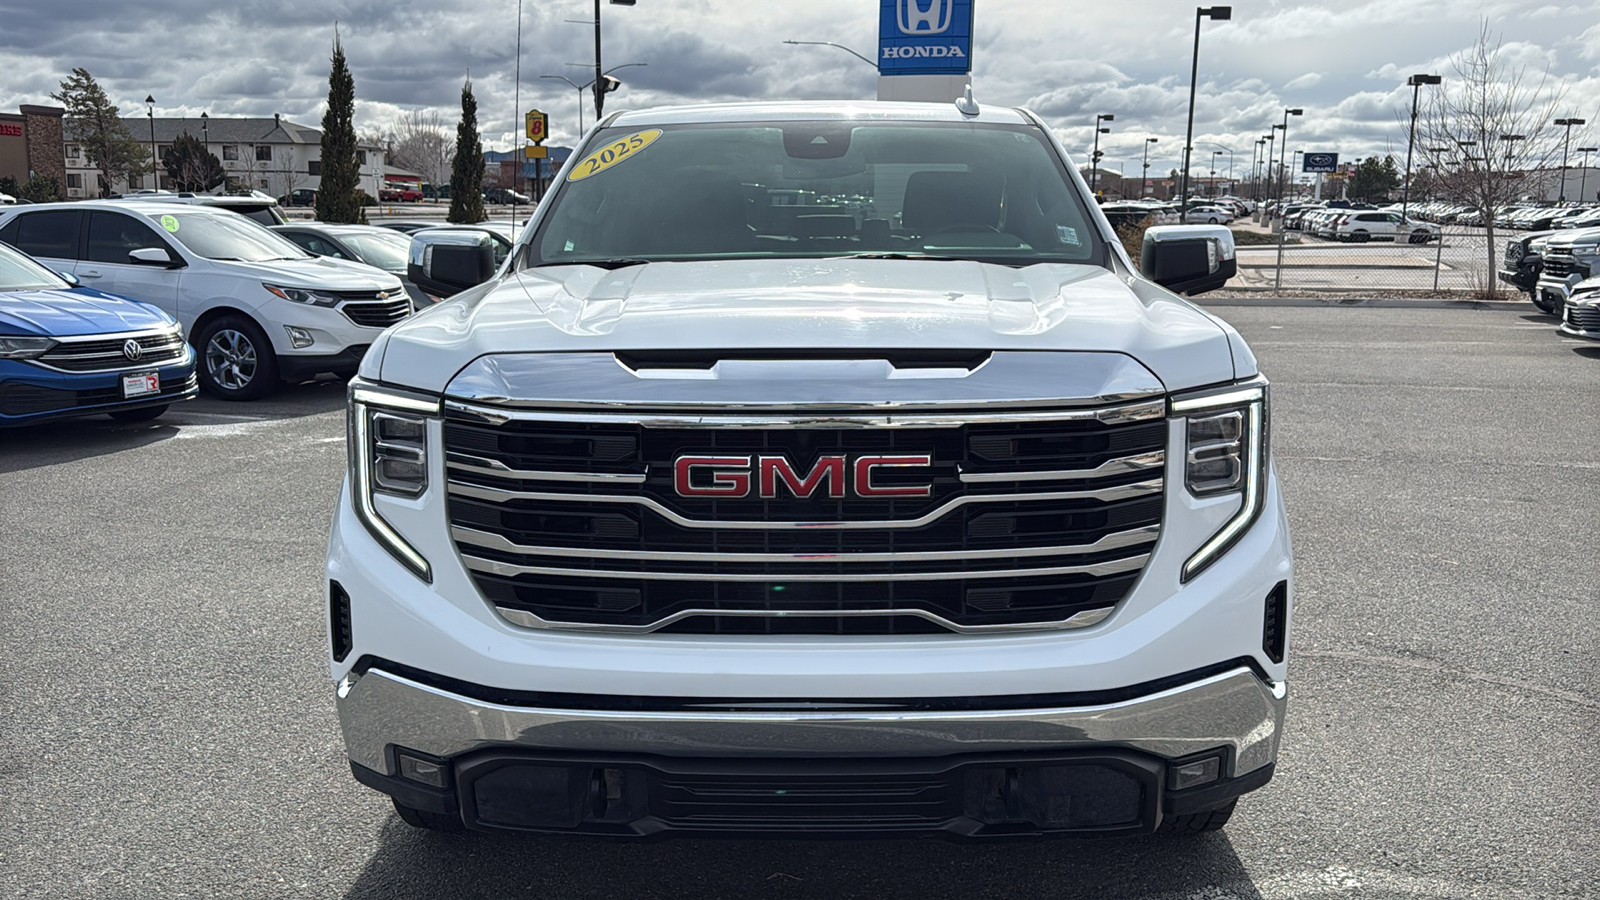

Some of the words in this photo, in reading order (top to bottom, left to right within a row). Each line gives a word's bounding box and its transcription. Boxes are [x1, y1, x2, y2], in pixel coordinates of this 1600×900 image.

[882, 46, 965, 58] HONDA
[531, 120, 542, 135] 8
[585, 134, 644, 174] 2025
[674, 454, 931, 498] GMC
